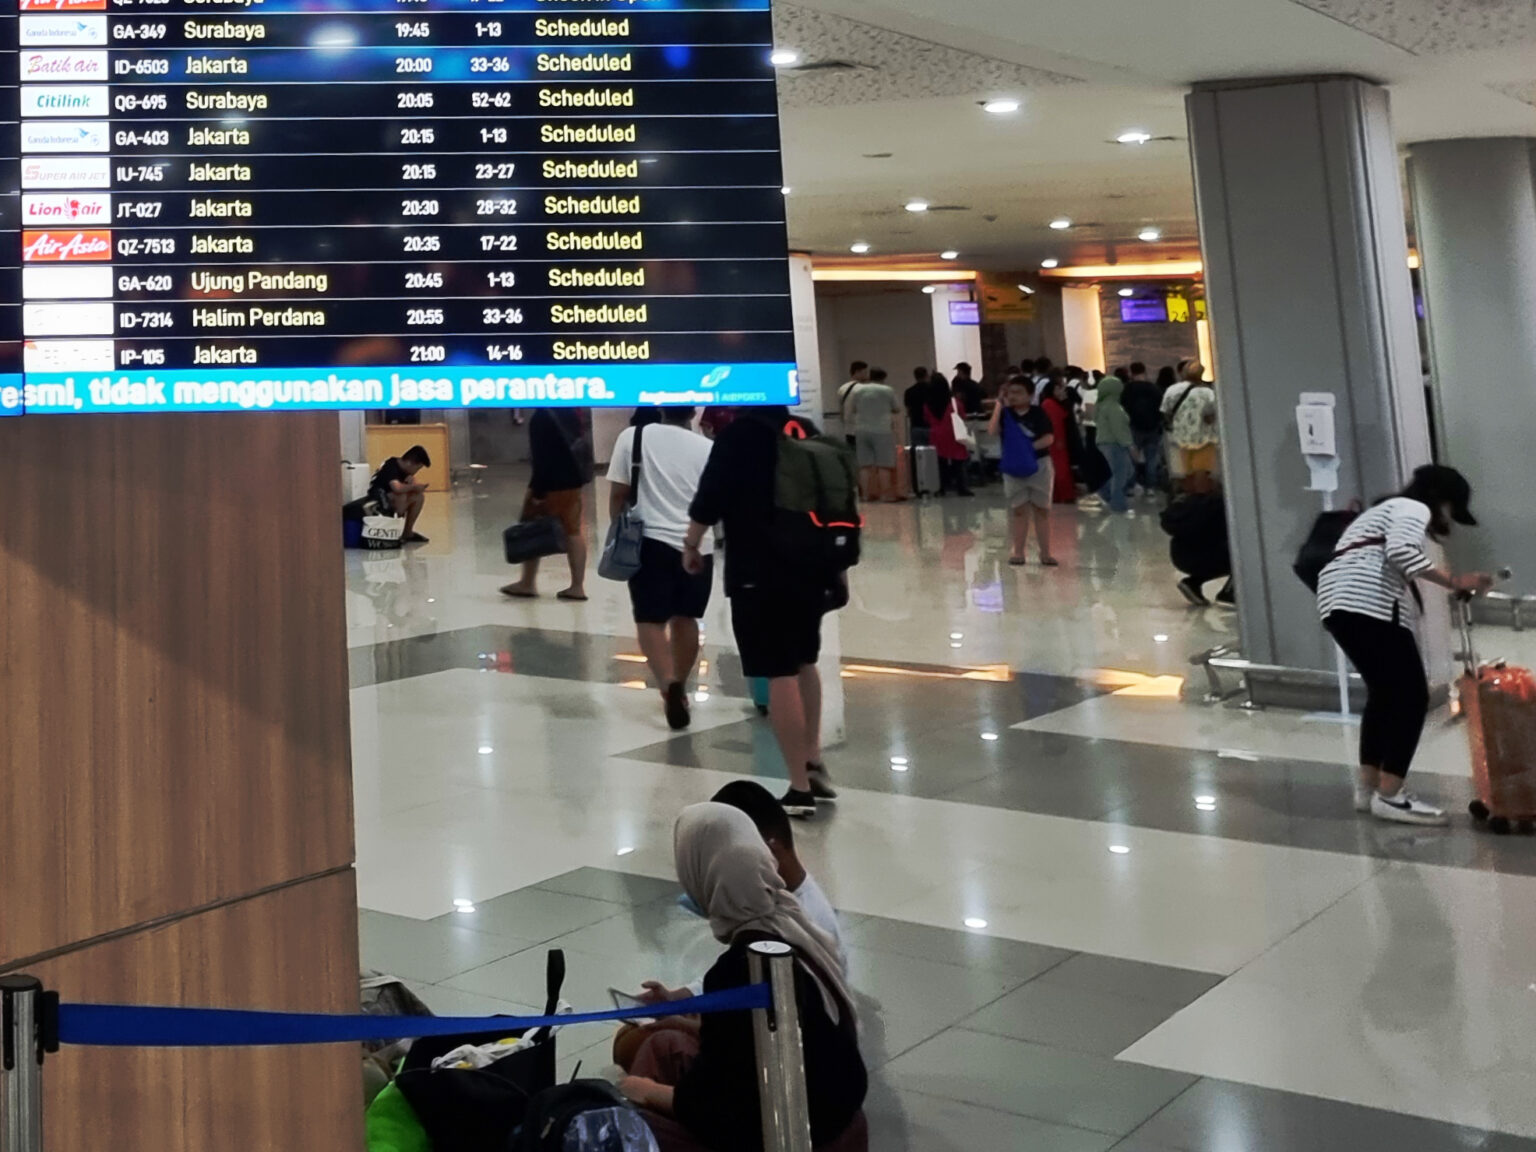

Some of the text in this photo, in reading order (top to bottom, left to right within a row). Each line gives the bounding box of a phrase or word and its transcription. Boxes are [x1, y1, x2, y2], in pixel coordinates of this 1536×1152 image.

[113, 19, 629, 41] GA-349 Surabaya 19:45 1-13 Scheduled
[115, 124, 635, 145] GA-403 Jakarta 20:15 1-13 Scheduled
[29, 201, 103, 216] Lion air
[117, 196, 640, 218] JT-027 Jakarta 20:30 28-32 Scheduled
[120, 304, 647, 328] ID-7314 Halim Perdana 20:55 33-36 Scheduled
[88, 376, 167, 405] tidak
[173, 374, 383, 409] menggunakan
[389, 373, 454, 407] jasa
[460, 373, 615, 406] perantara.
